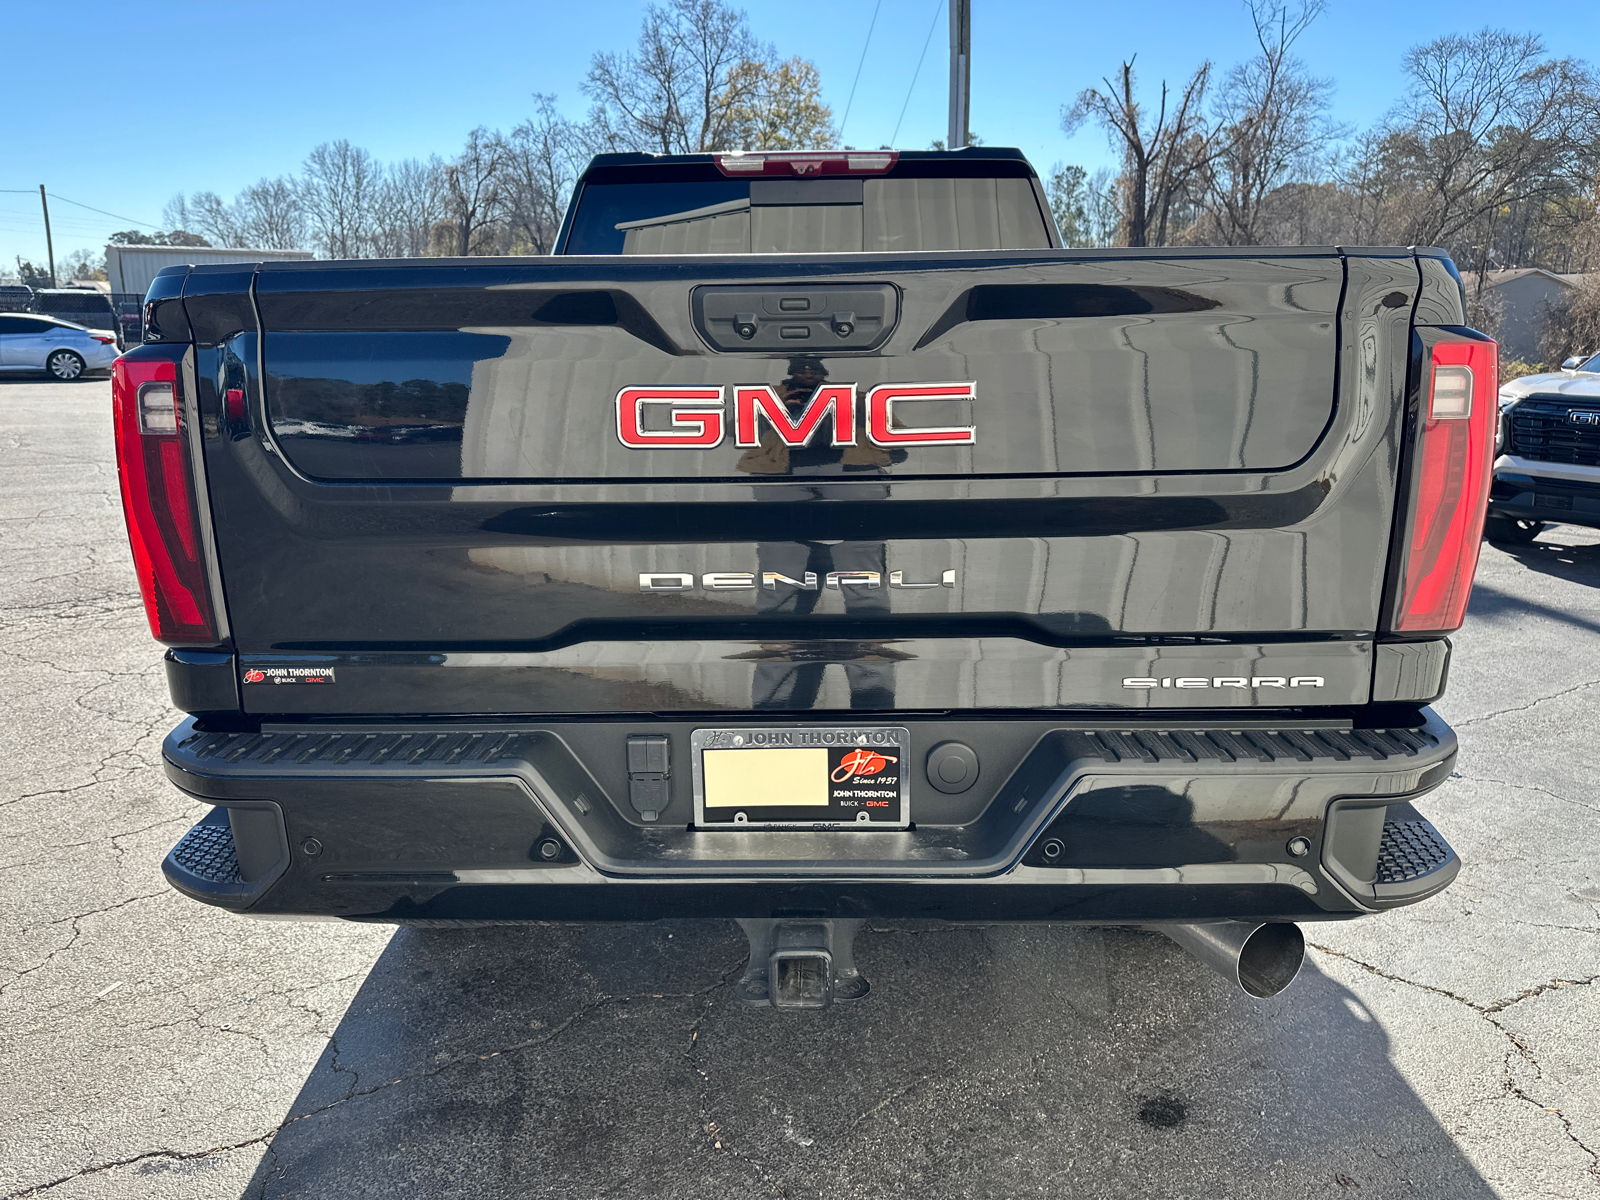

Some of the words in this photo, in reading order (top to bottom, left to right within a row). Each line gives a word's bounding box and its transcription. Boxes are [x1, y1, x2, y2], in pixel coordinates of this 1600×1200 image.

[615, 380, 977, 449] GMC
[639, 569, 956, 592] DENALI
[266, 668, 288, 677] JOHN
[288, 668, 332, 677] THORNTON
[1122, 676, 1325, 689] SIERRA
[746, 732, 794, 745] JOHN
[799, 731, 899, 745] THORNTON
[852, 776, 876, 784] Since
[876, 776, 898, 785] 1957
[833, 790, 853, 798] JOHN
[853, 790, 897, 798] THORNTON
